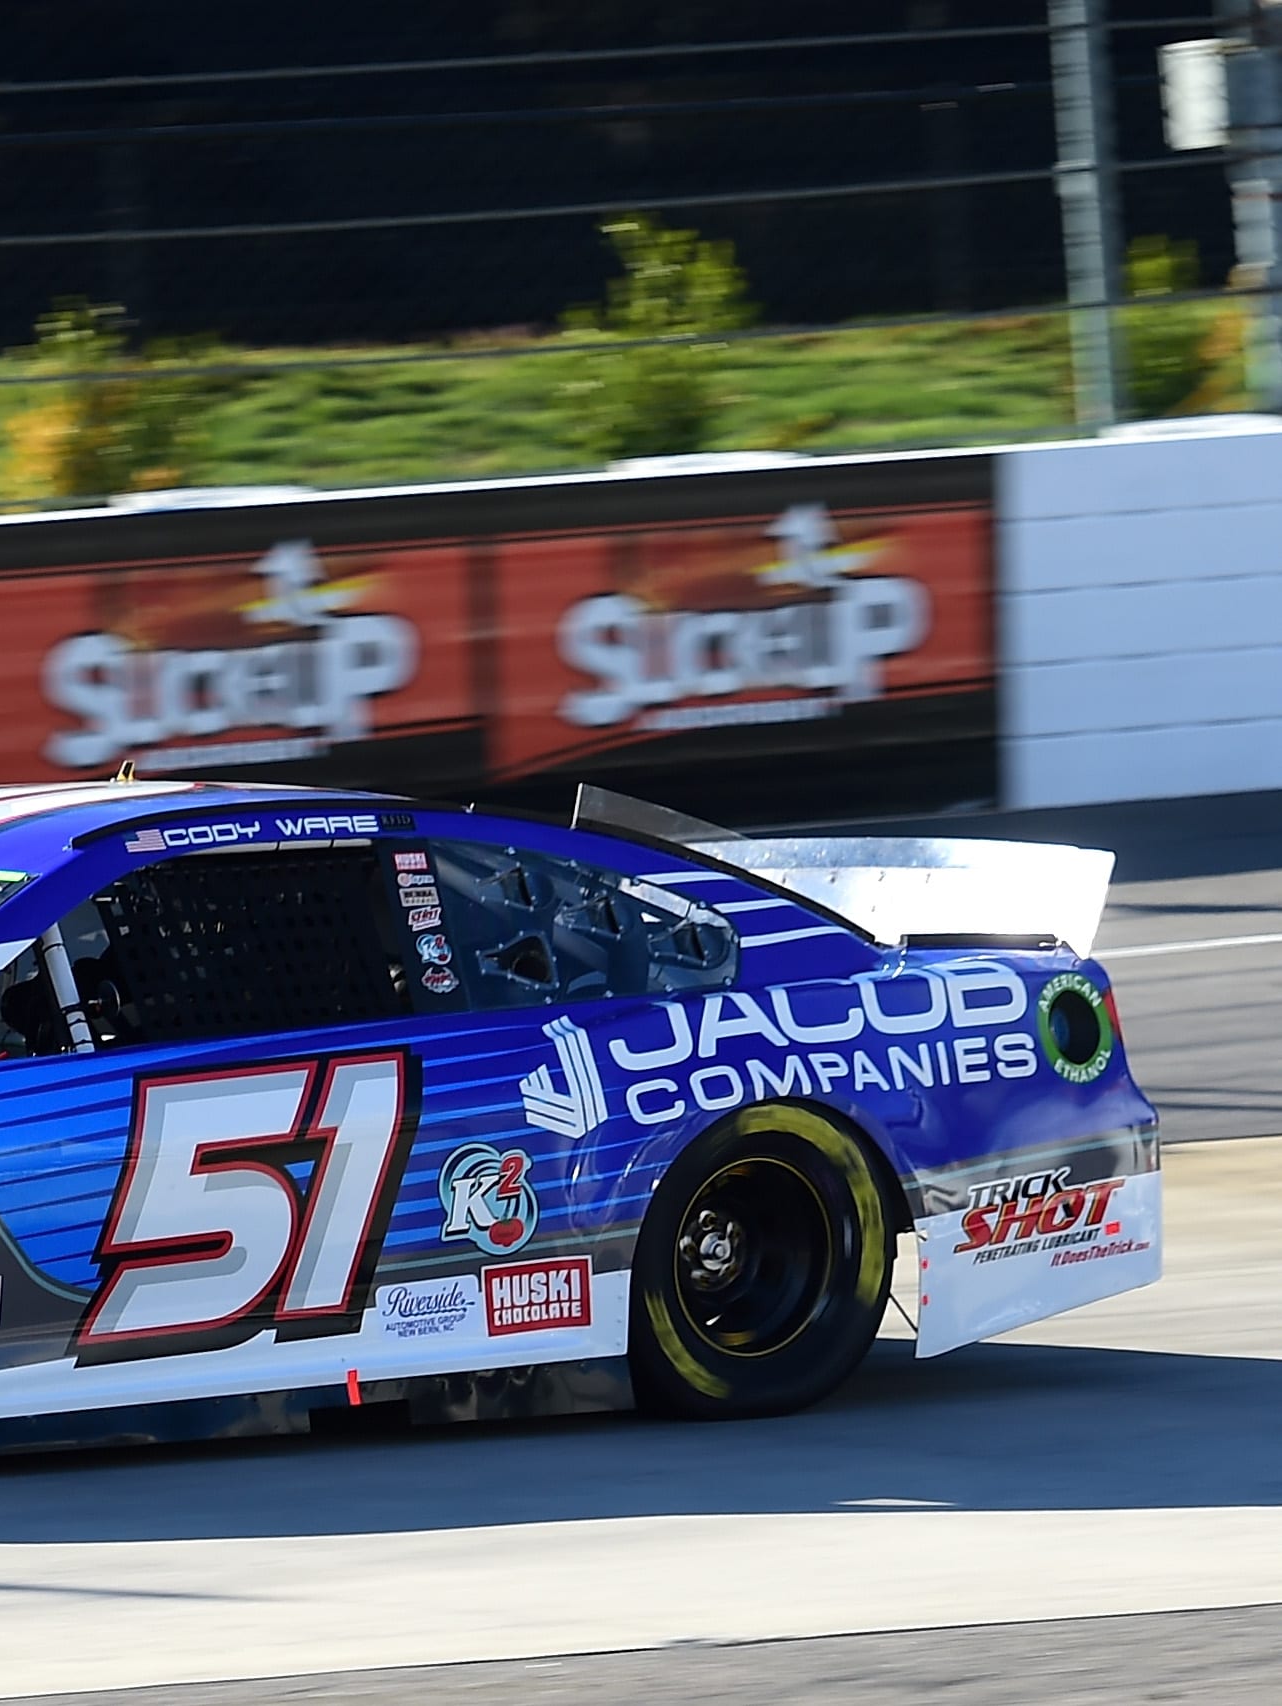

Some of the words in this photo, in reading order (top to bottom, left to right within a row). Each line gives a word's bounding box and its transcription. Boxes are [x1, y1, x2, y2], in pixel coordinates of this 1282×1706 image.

[163, 820, 260, 846] CODY
[276, 815, 379, 836] WARE
[1038, 974, 1103, 1012] AMERICAN
[609, 959, 1028, 1072] JACOB
[625, 1032, 1038, 1126] COMPANIES
[1054, 1049, 1111, 1083] ETHANOL
[78, 1051, 405, 1346] 51
[970, 1167, 1070, 1207] TRICK
[953, 1180, 1125, 1254] SHOT
[973, 1239, 1041, 1265] PENETRATING
[1042, 1227, 1101, 1251] LUBRICANT
[382, 1282, 468, 1317] Riverside
[491, 1267, 581, 1309] HUSKI
[385, 1316, 435, 1332] AUTOMOTIVE
[436, 1313, 466, 1325] GROUP
[398, 1328, 416, 1338] NEW
[443, 1324, 455, 1332] NC
[493, 1301, 582, 1327] CHOCOLATE
